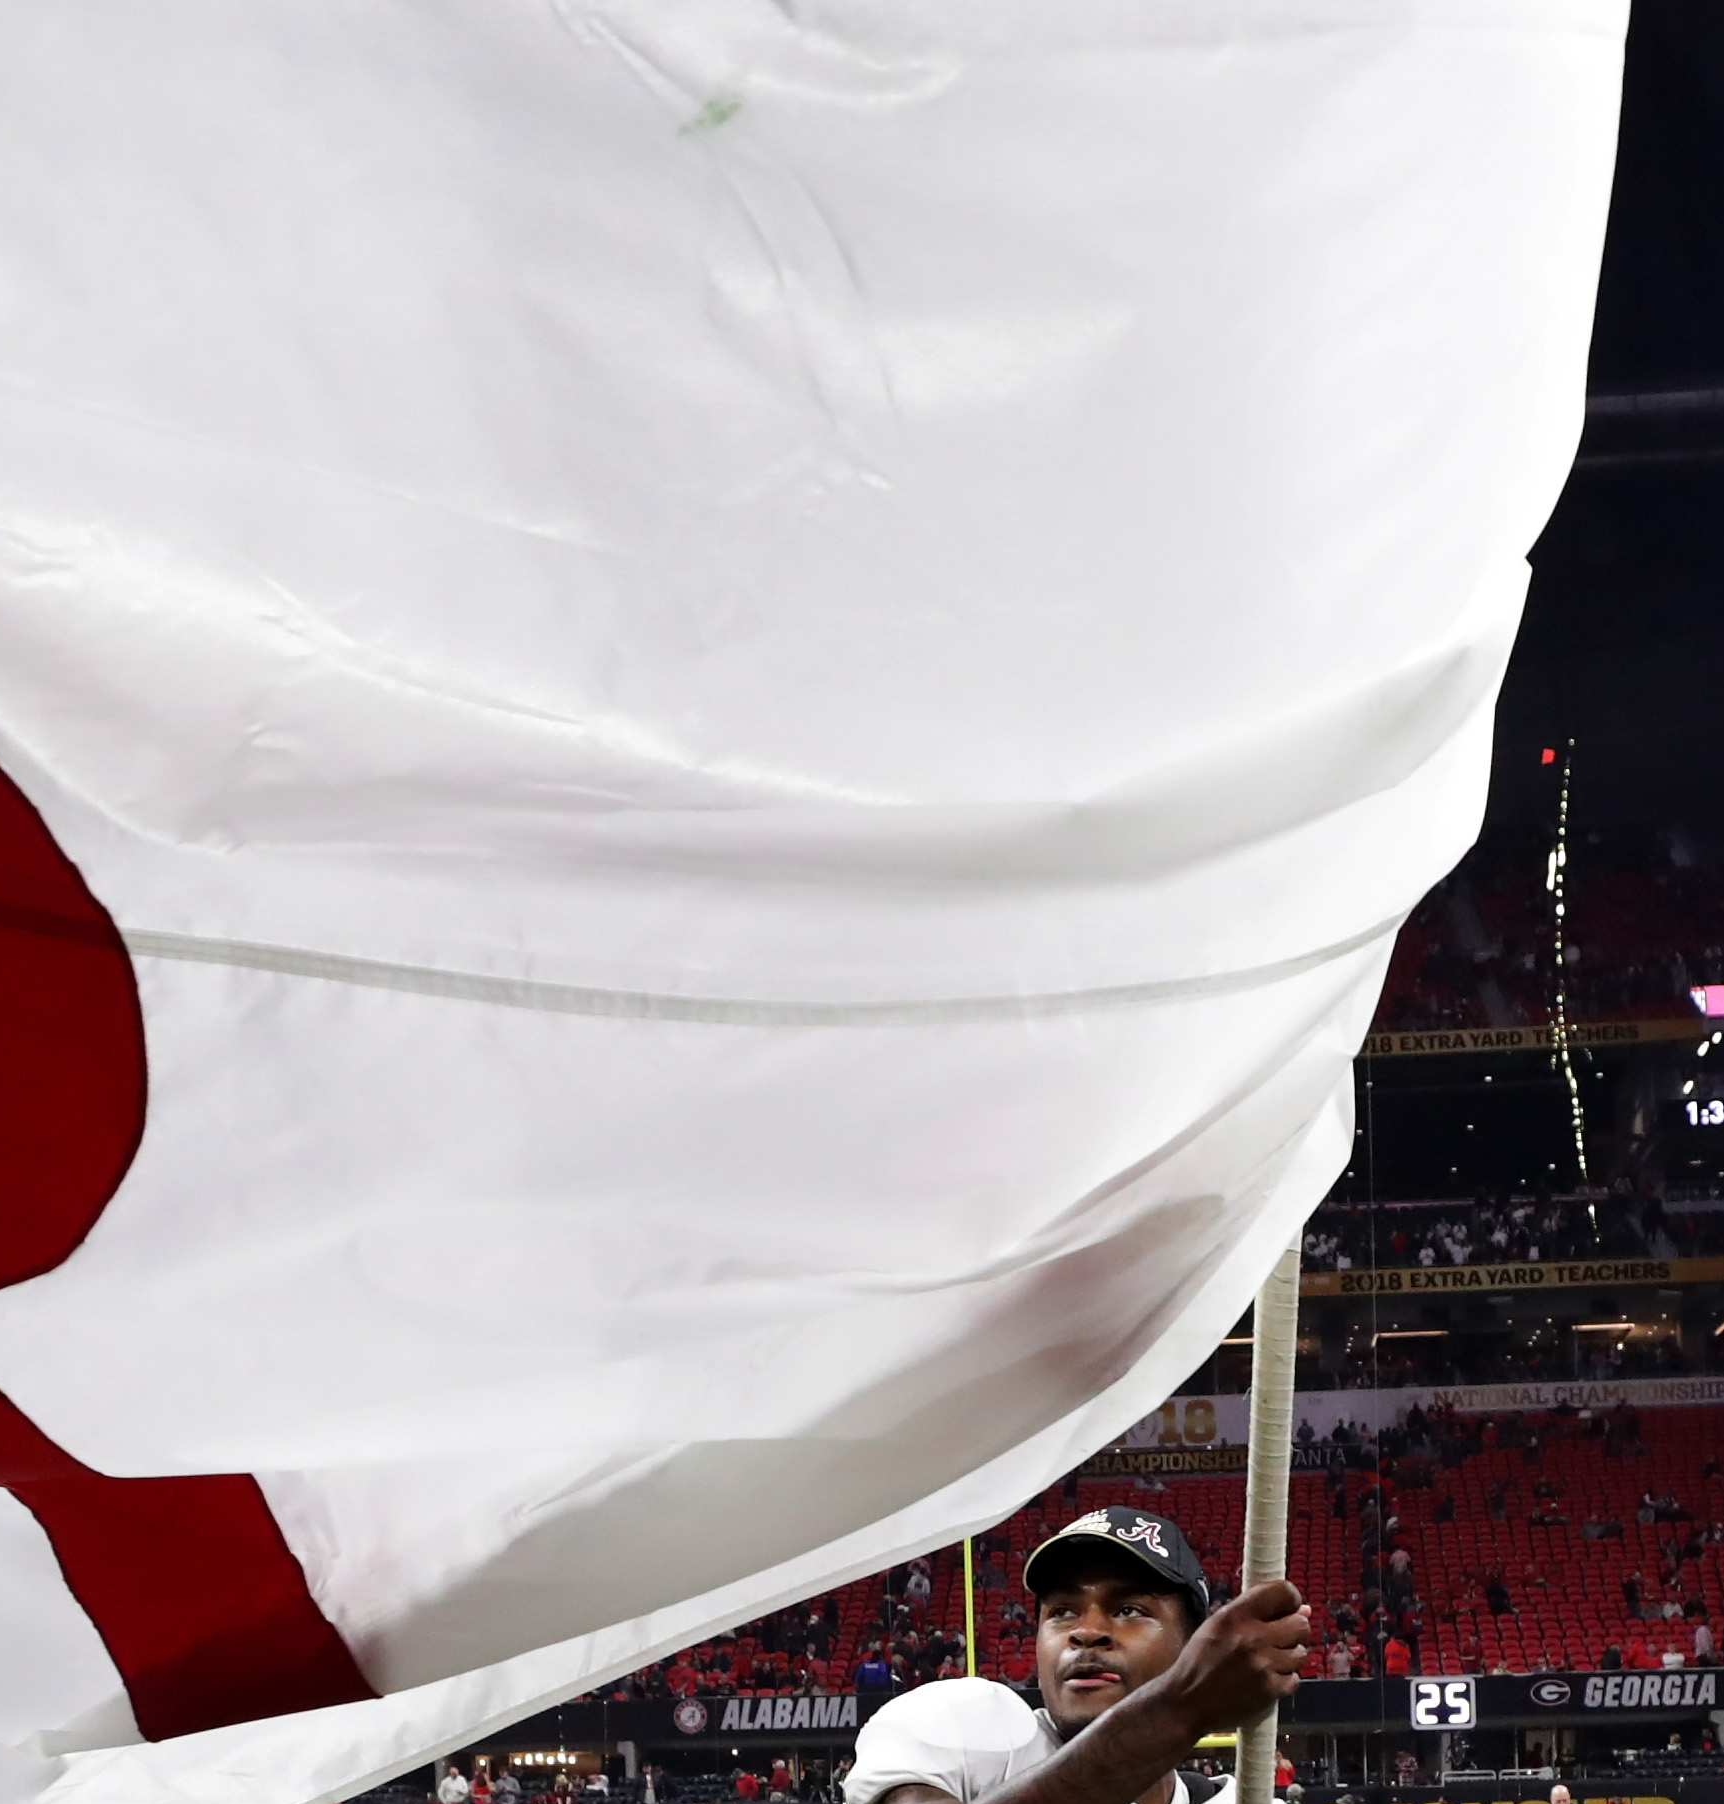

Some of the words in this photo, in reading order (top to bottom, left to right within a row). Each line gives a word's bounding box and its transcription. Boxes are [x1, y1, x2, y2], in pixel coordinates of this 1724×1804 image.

[1365, 1034, 1393, 1054] 18
[1400, 1030, 1467, 1053] EXTRA
[1470, 1029, 1523, 1048] YARD
[1532, 1022, 1640, 1045] TEACHERS
[1410, 1270, 1483, 1290] EXTRA
[1484, 1268, 1544, 1287] YARD
[1554, 1262, 1670, 1284] TEACHERS
[1434, 1388, 1548, 1410] NATIONAL
[1147, 1399, 1218, 1444] 18
[1293, 1447, 1347, 1466] ANTA
[1415, 1683, 1471, 1725] 25
[1583, 1673, 1716, 1708] GEORGIA
[720, 1696, 858, 1731] ALABAMA
